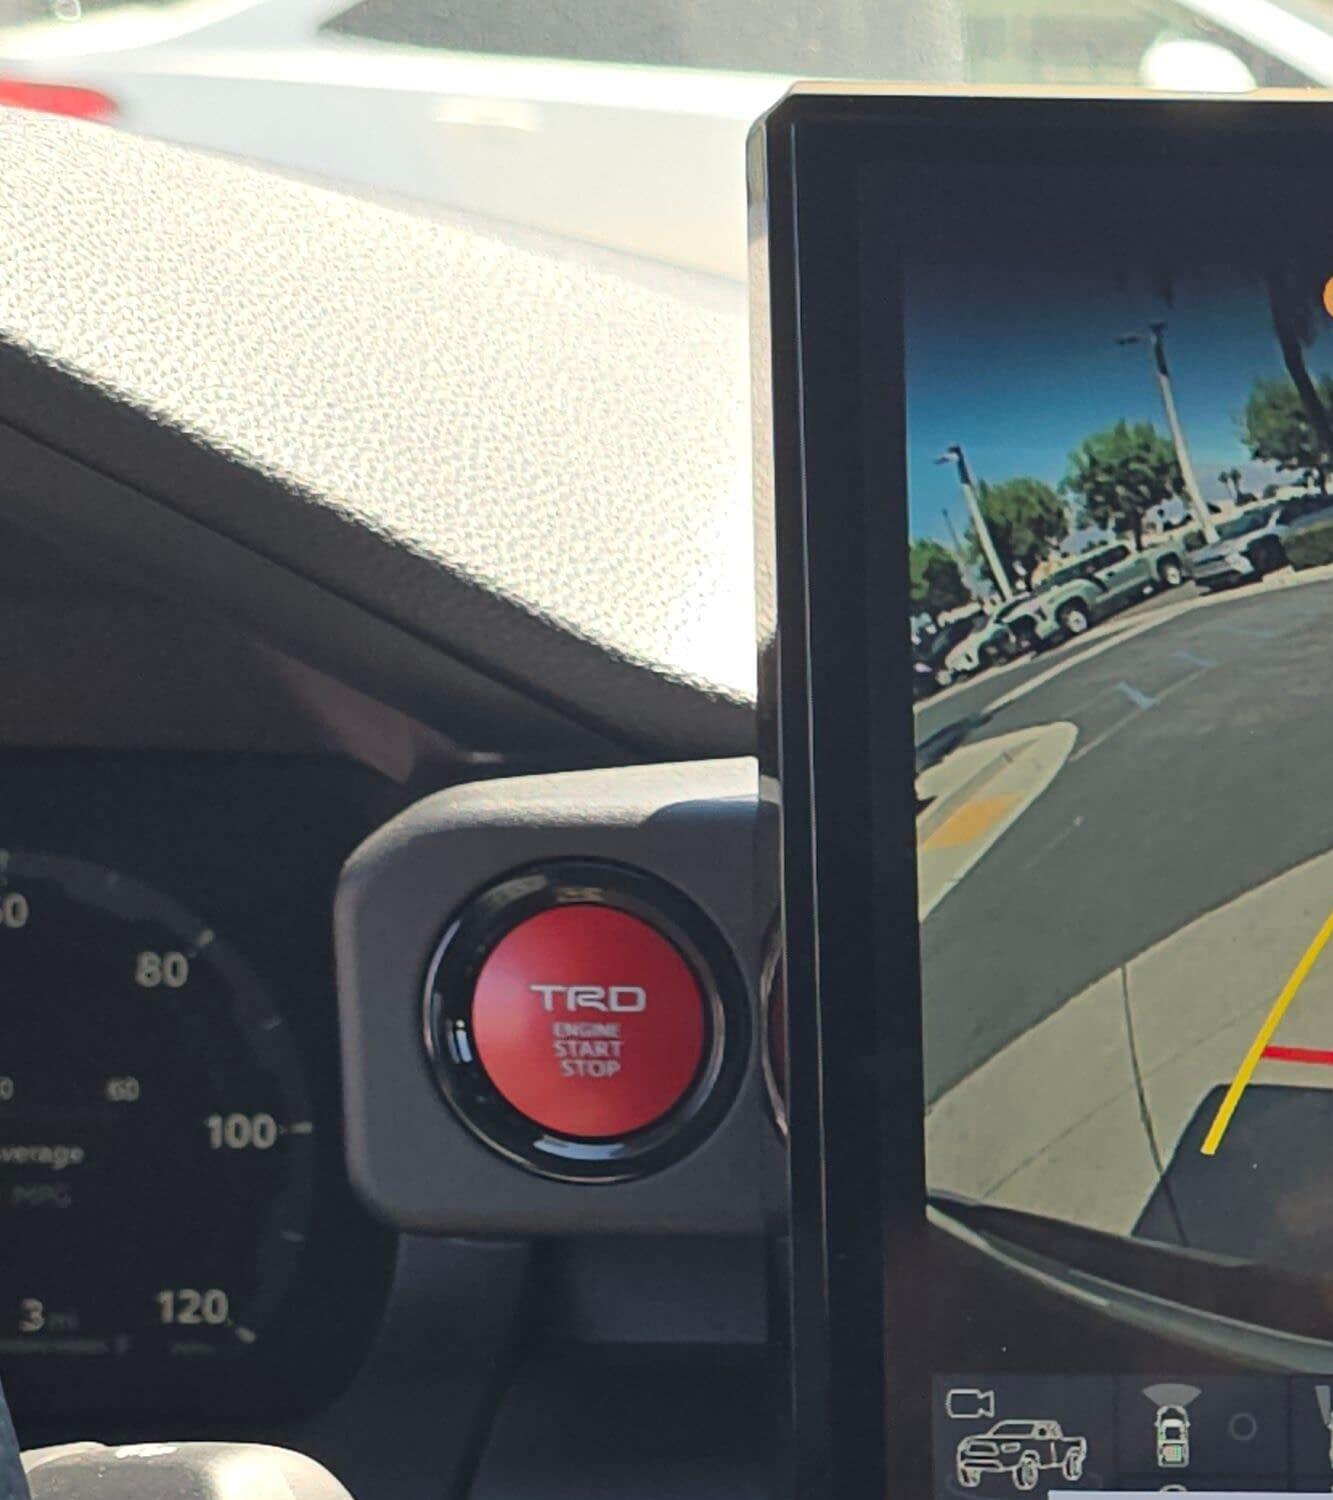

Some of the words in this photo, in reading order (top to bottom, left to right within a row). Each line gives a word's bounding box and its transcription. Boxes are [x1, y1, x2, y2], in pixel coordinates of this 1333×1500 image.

[0, 893, 28, 928] 0
[135, 951, 188, 988] 80
[530, 984, 647, 1012] TRD
[553, 1022, 620, 1038] ENGINE
[553, 1040, 623, 1057] START
[560, 1058, 621, 1077] STOP
[204, 1113, 277, 1149] 100
[19, 1299, 45, 1331] 3
[157, 1289, 228, 1324] 120
